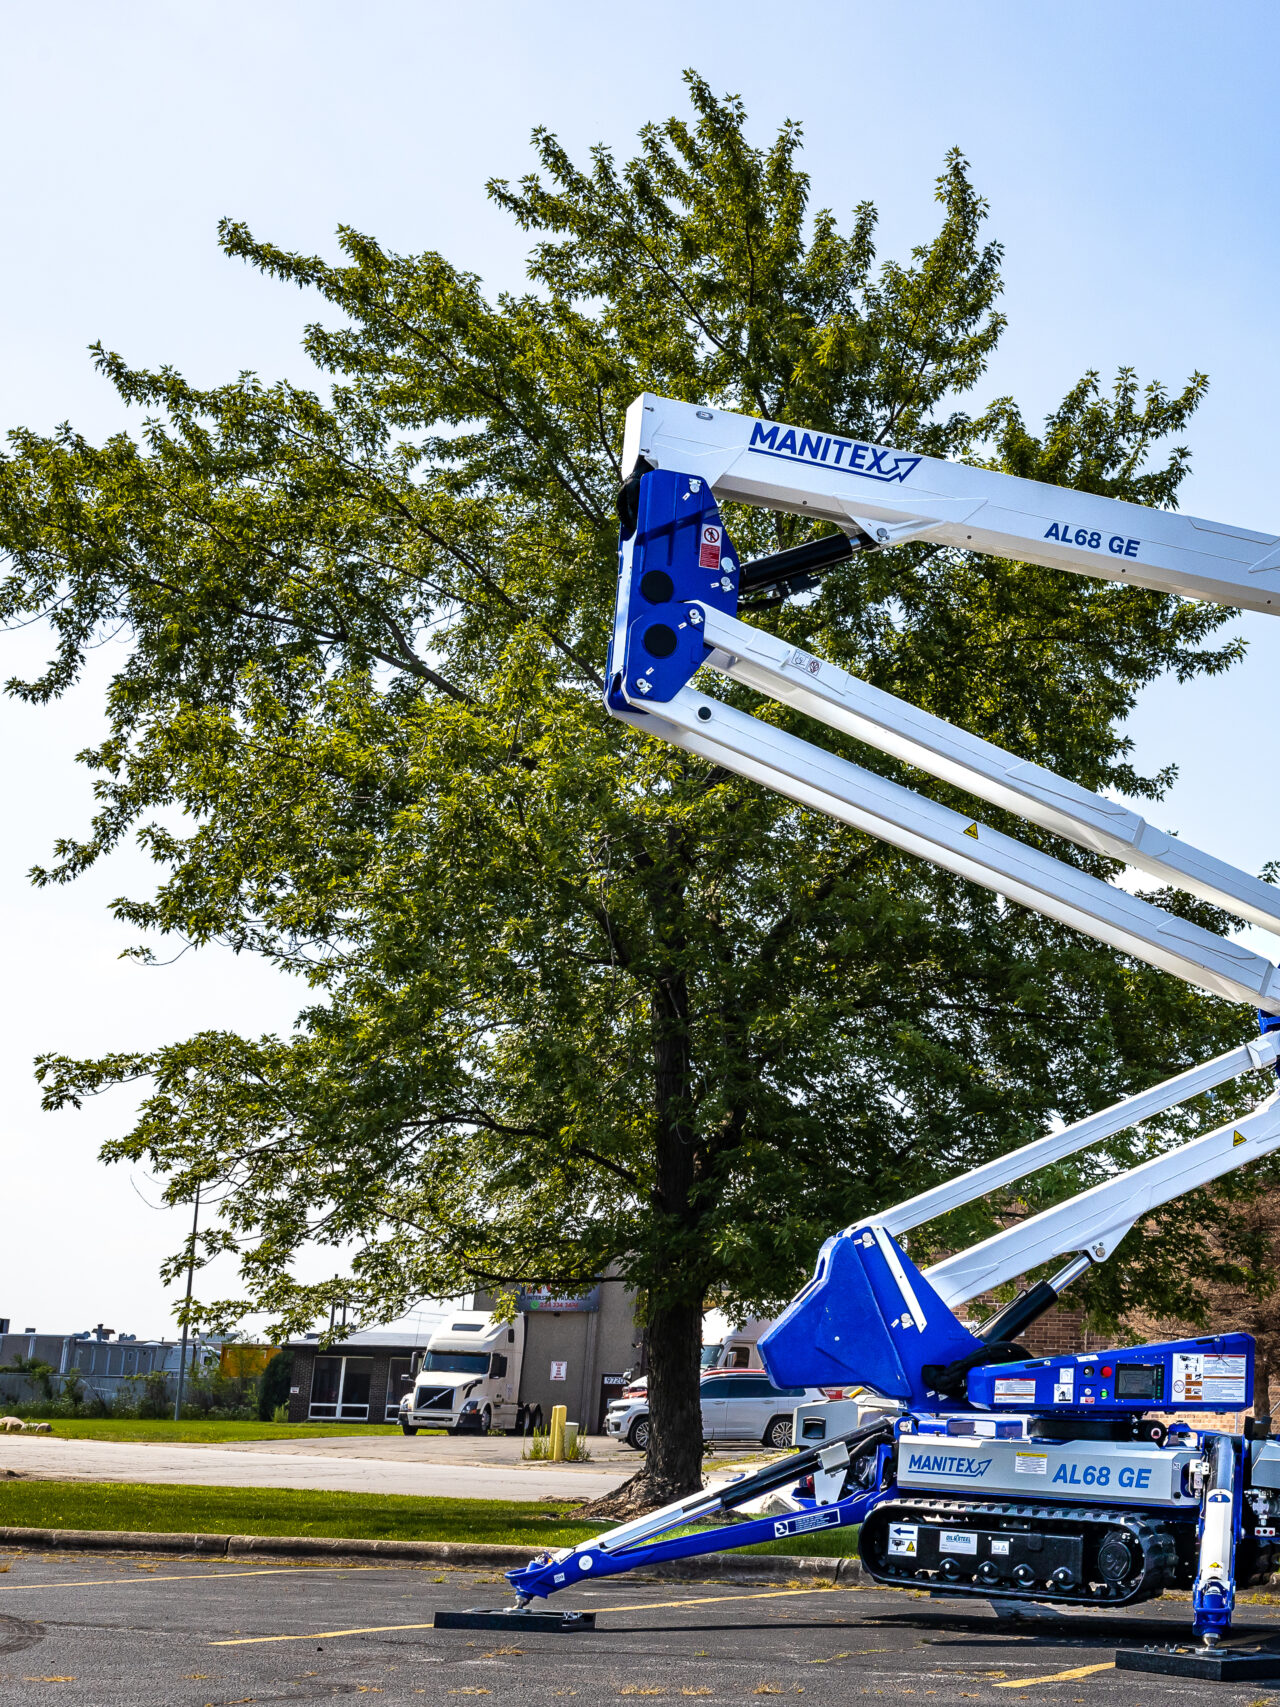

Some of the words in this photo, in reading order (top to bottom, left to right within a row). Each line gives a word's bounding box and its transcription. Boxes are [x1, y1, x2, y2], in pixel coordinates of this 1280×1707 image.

[750, 422, 890, 475] MANITEX
[1044, 523, 1101, 549] AL68
[1109, 536, 1140, 557] GE
[909, 1454, 976, 1474] MANITEX
[1052, 1463, 1111, 1486] AL68
[1118, 1467, 1152, 1488] GE
